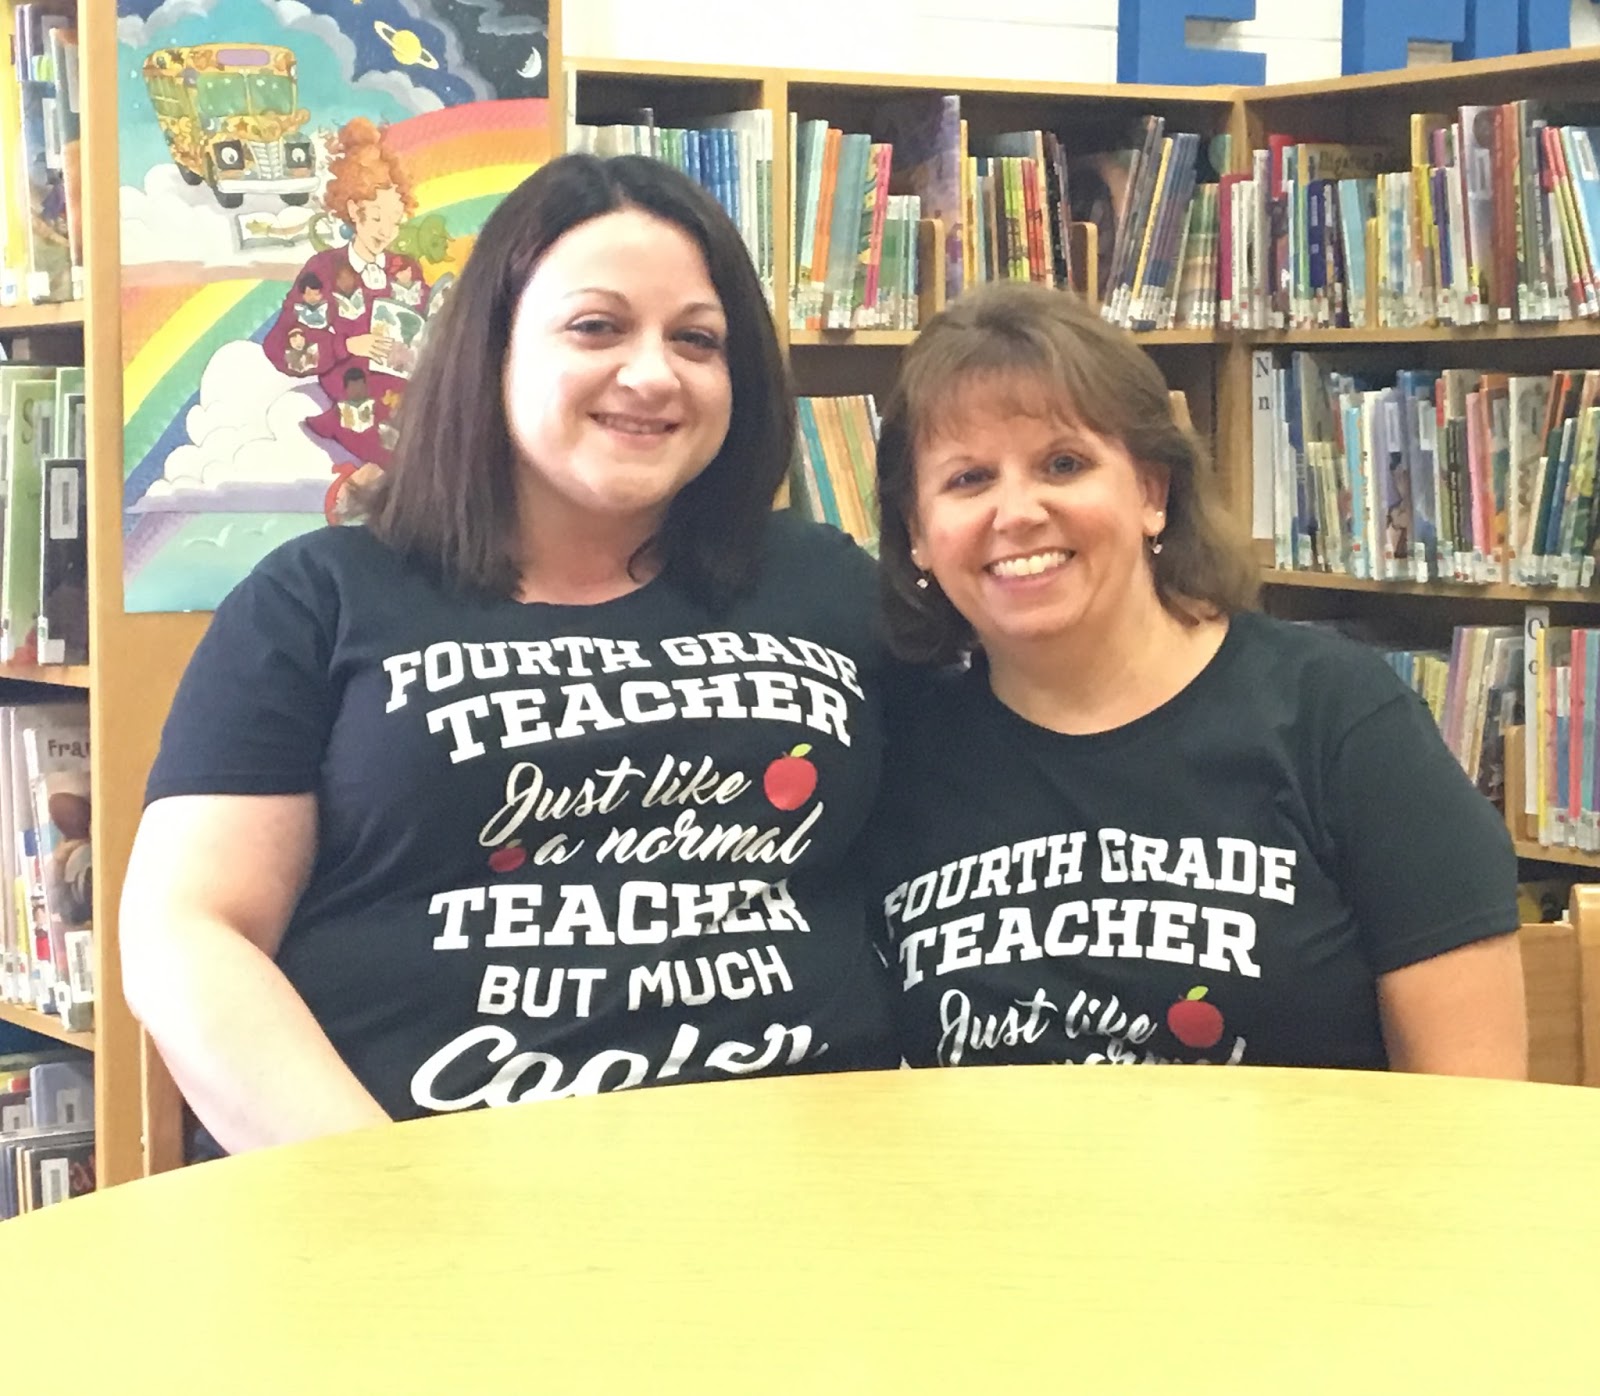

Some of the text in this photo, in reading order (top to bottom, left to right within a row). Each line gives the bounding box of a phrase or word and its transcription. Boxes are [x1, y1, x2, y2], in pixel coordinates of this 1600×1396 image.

[1256, 356, 1270, 378] N
[1258, 396, 1270, 410] n
[383, 631, 866, 713] FOURTH GRADE
[426, 670, 852, 764] TEACHER
[478, 754, 752, 847] Just like
[533, 801, 825, 866] a normal
[428, 878, 811, 951] TEACHER
[883, 828, 1298, 941] FOURTH GRADE
[476, 944, 794, 1018] BUT MUCH
[898, 898, 1262, 992] TEACHER
[410, 1023, 830, 1111] Cooler
[937, 987, 1058, 1067] Just
[1065, 990, 1158, 1044] like
